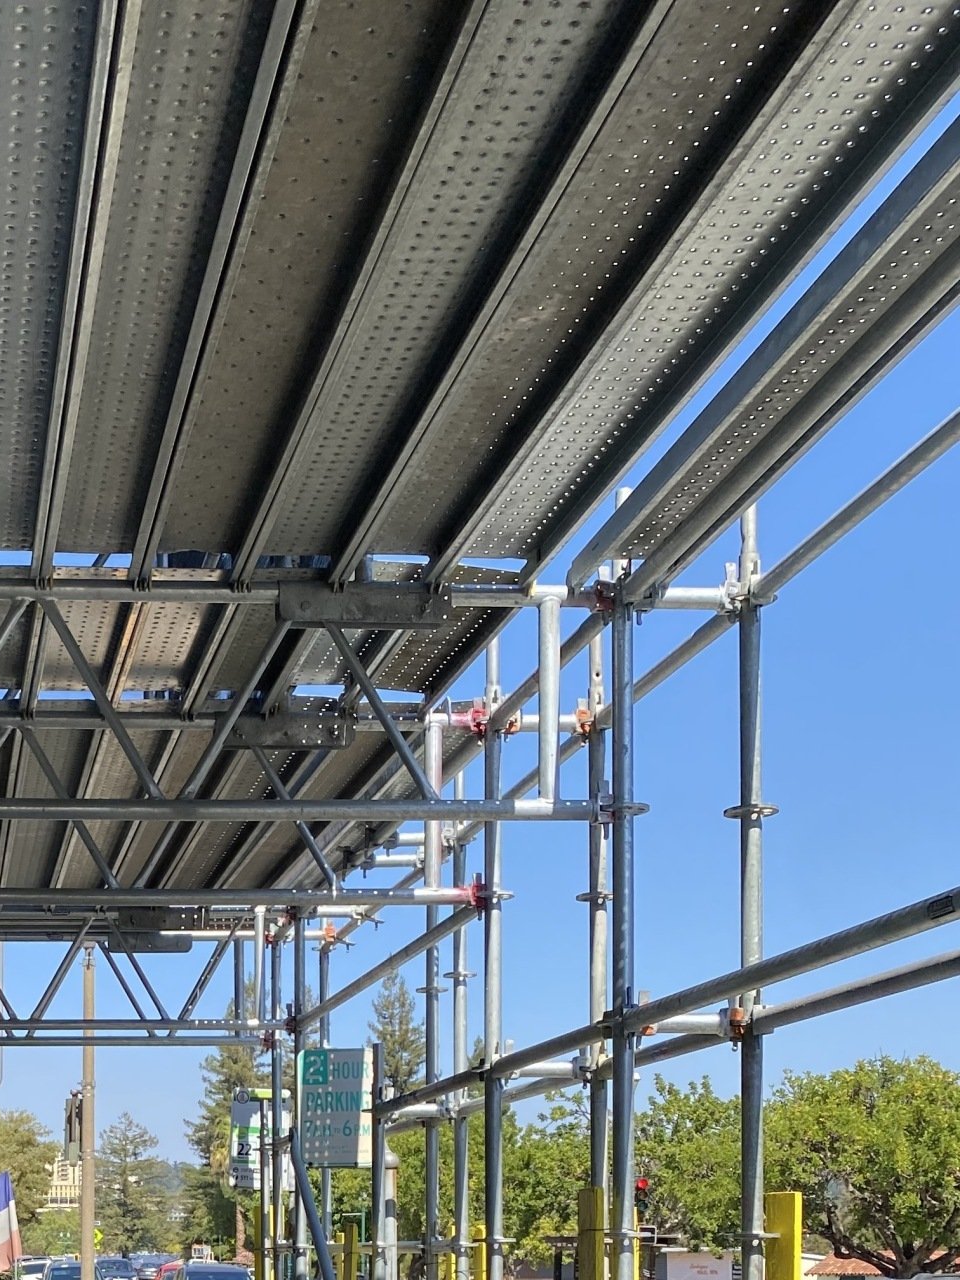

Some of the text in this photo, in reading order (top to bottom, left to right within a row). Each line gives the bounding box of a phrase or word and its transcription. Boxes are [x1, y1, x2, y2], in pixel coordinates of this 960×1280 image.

[305, 1056, 369, 1080] 2 HOUR
[306, 1090, 370, 1113] PARKING
[237, 1143, 252, 1156] 22
